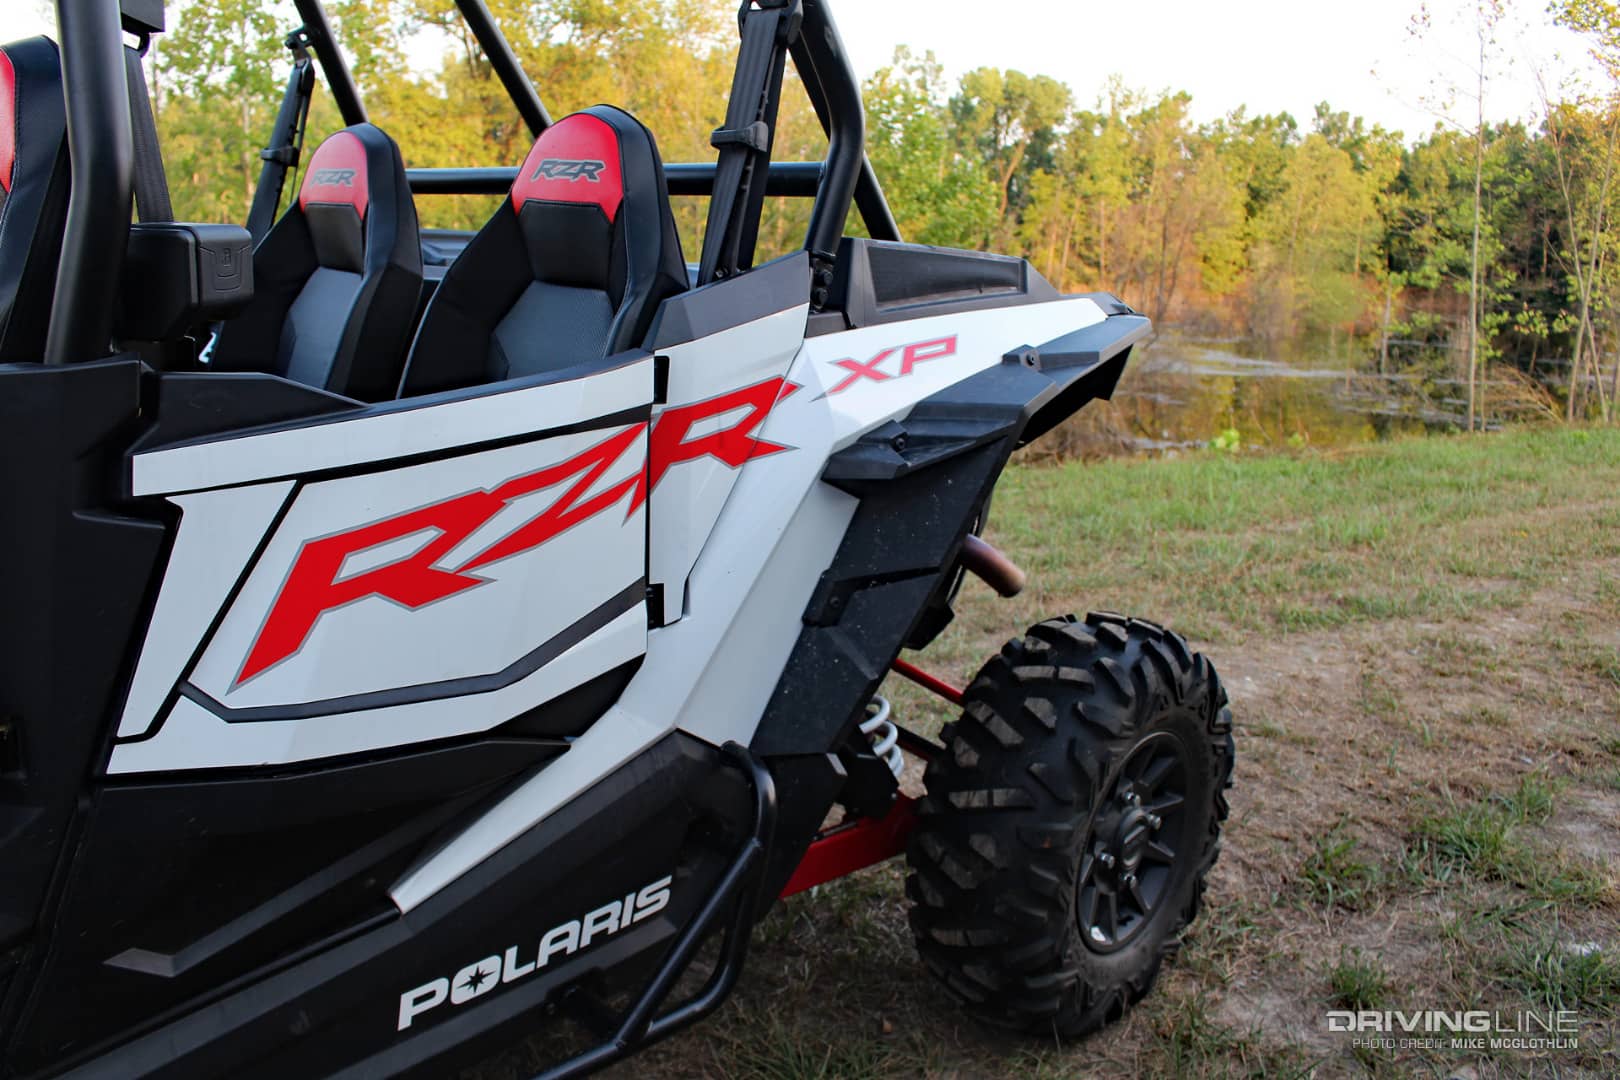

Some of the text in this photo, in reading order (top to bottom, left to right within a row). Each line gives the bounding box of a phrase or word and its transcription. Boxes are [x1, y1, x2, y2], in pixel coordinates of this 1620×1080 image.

[310, 168, 356, 187] RZR
[531, 160, 605, 183] RZR
[226, 335, 958, 695] RZR XP
[397, 876, 672, 1031] POLARIS
